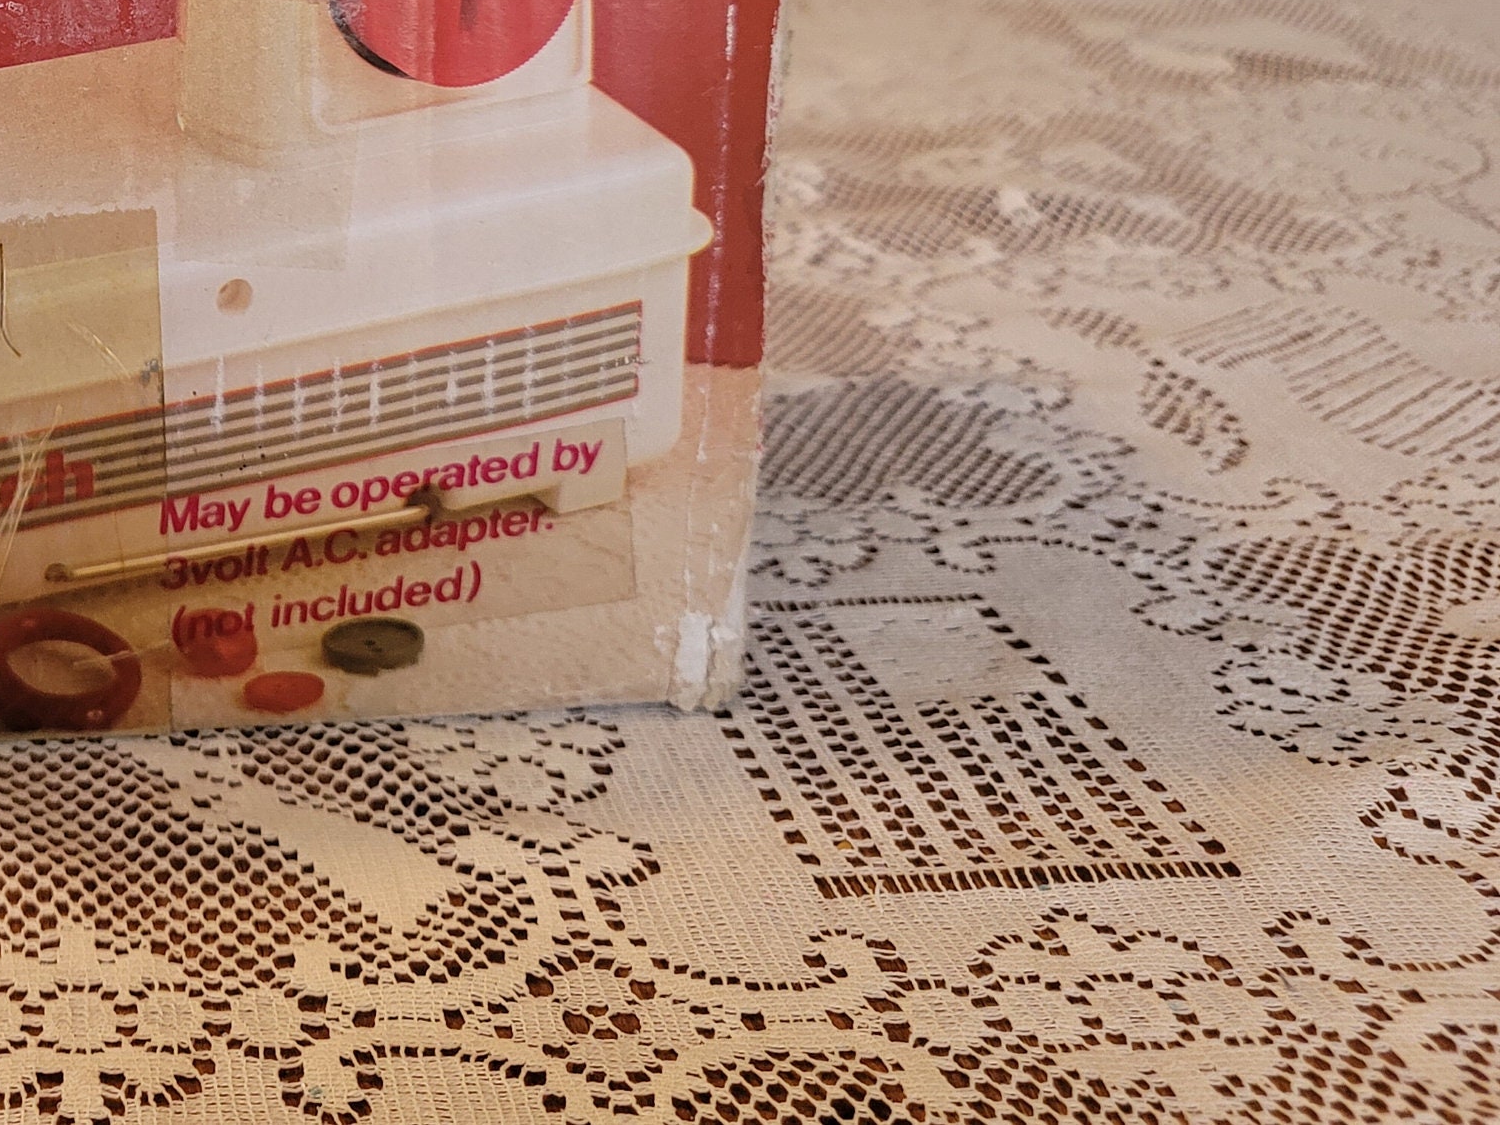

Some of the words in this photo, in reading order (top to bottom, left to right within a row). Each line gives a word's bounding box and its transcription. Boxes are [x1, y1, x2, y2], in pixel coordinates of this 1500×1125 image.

[159, 496, 251, 535] May
[264, 484, 320, 520] be
[331, 442, 540, 510] operated
[553, 438, 603, 474] by
[160, 545, 269, 590] 3volt
[282, 528, 366, 573] A.C.
[374, 505, 555, 559] adapter.
[171, 602, 256, 652] (not
[270, 561, 483, 630] included)
